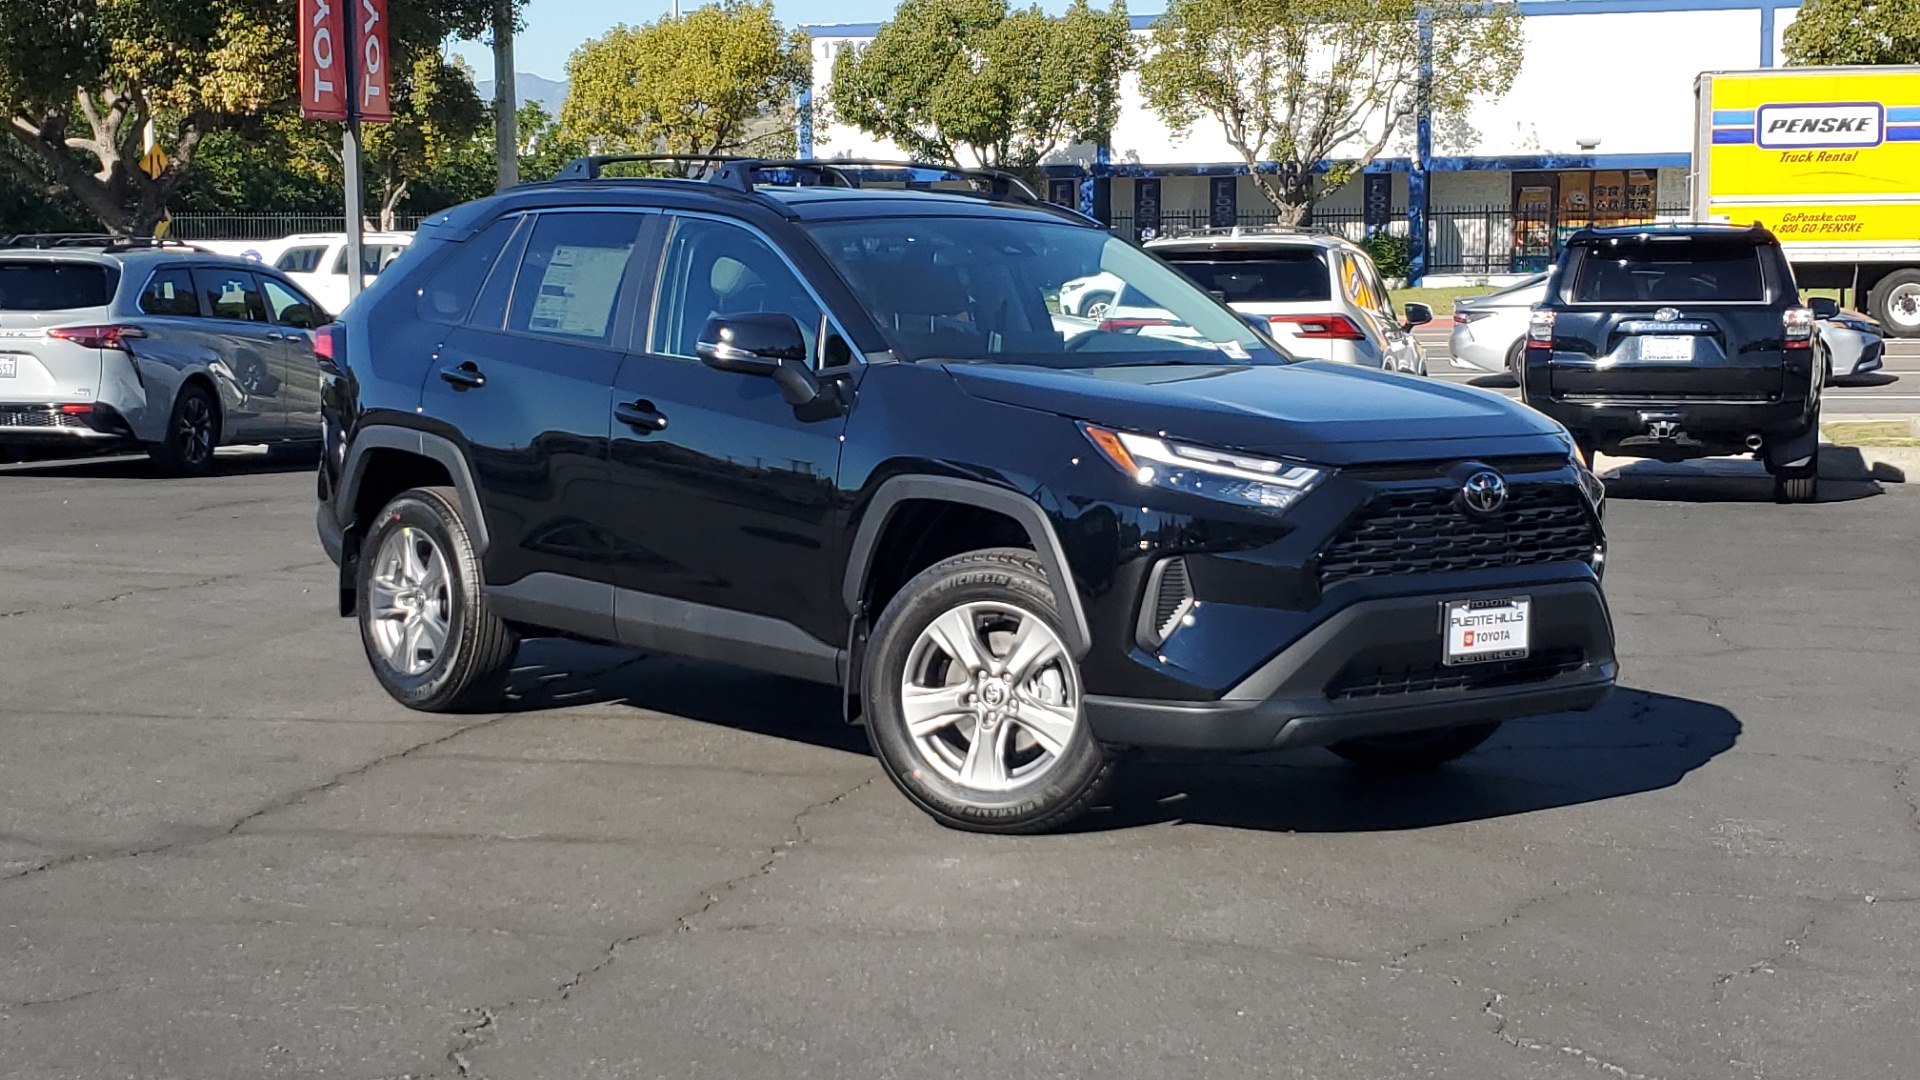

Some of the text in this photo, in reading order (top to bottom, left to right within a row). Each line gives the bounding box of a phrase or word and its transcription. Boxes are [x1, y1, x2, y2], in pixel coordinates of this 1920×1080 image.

[1767, 117, 1873, 133] PENSKE
[1779, 150, 1859, 163] Truck Rental
[1782, 212, 1857, 222] GoPenske.com
[1772, 222, 1865, 234] 1-800-GO-PENSKE
[940, 574, 1010, 591] MICHELIN
[1470, 598, 1511, 609] TOYOTA
[1451, 611, 1524, 627] PUENTE HILLS
[1476, 630, 1511, 642] TOYOTA
